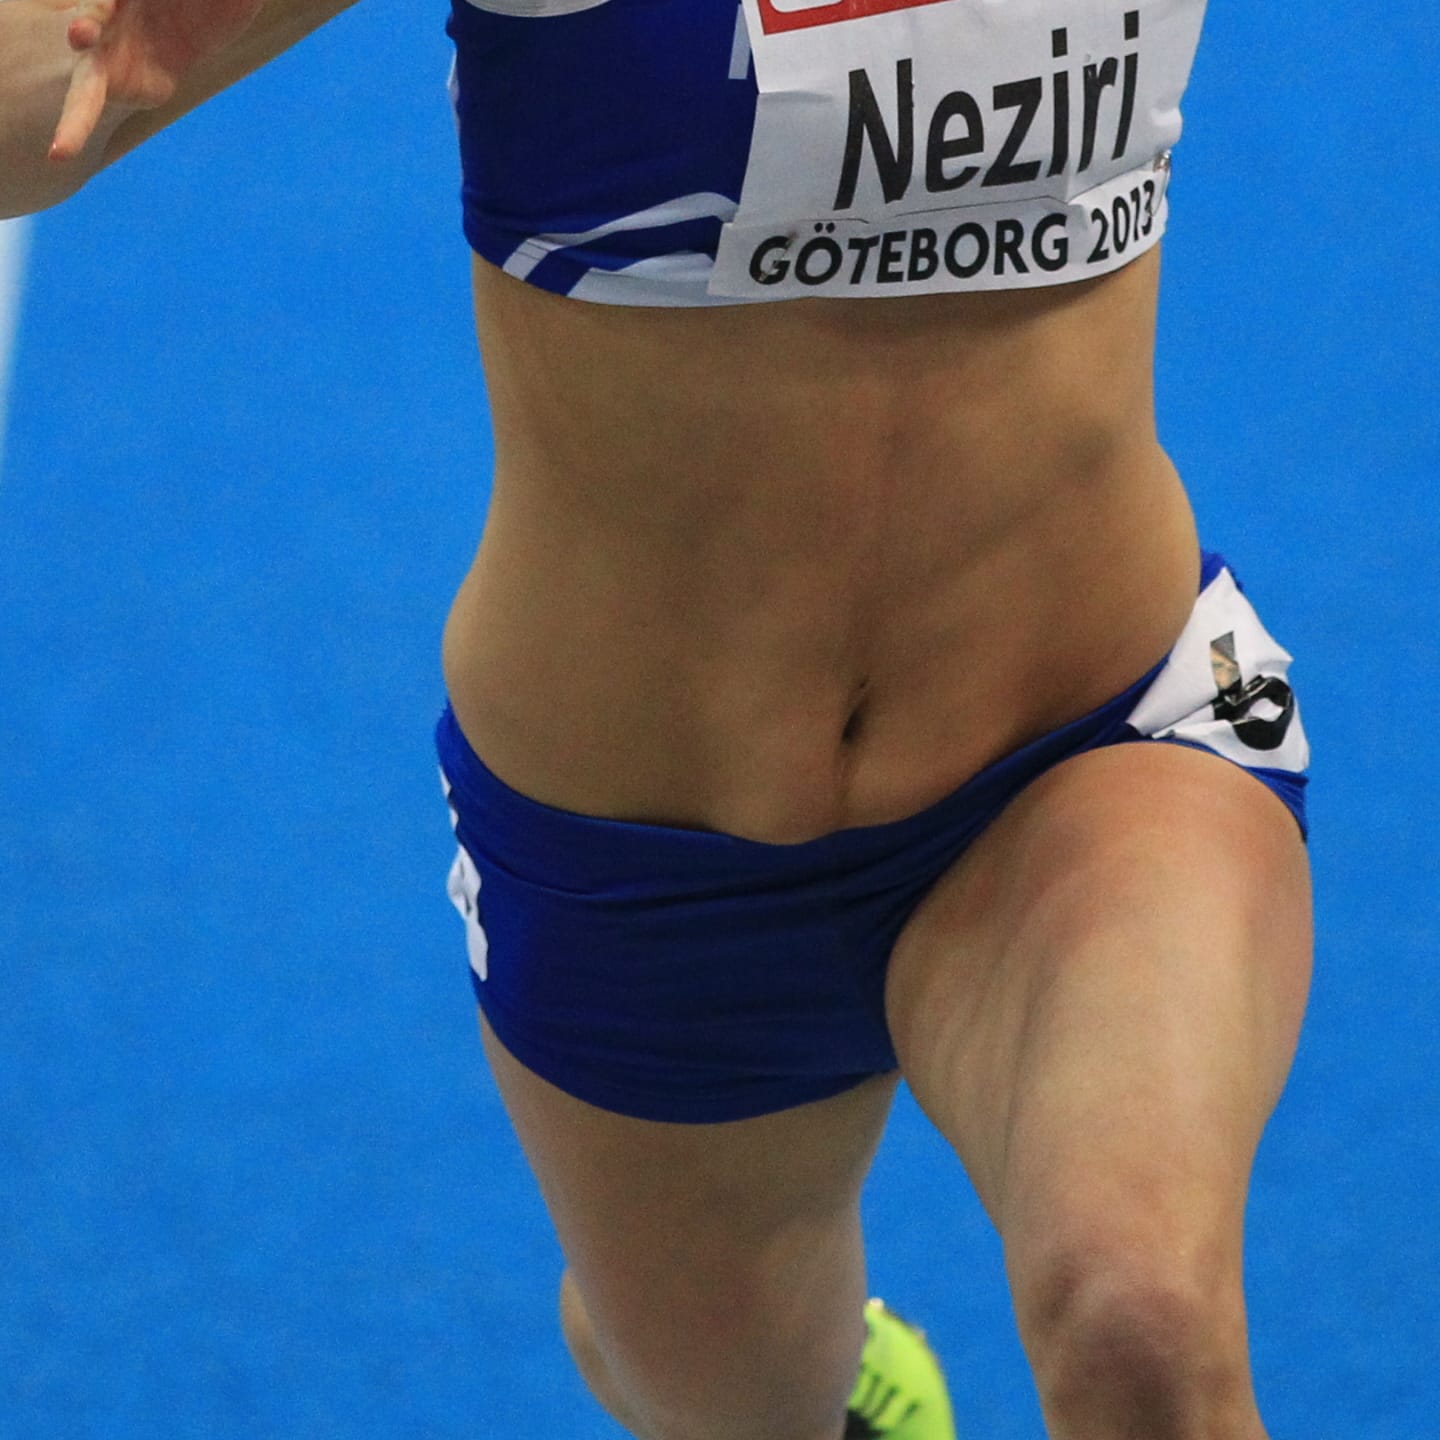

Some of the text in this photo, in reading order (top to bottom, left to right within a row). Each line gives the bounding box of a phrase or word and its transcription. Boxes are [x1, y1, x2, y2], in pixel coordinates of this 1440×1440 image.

[833, 9, 1140, 211] Neziri
[748, 179, 1155, 286] GÖTEBORG 2013
